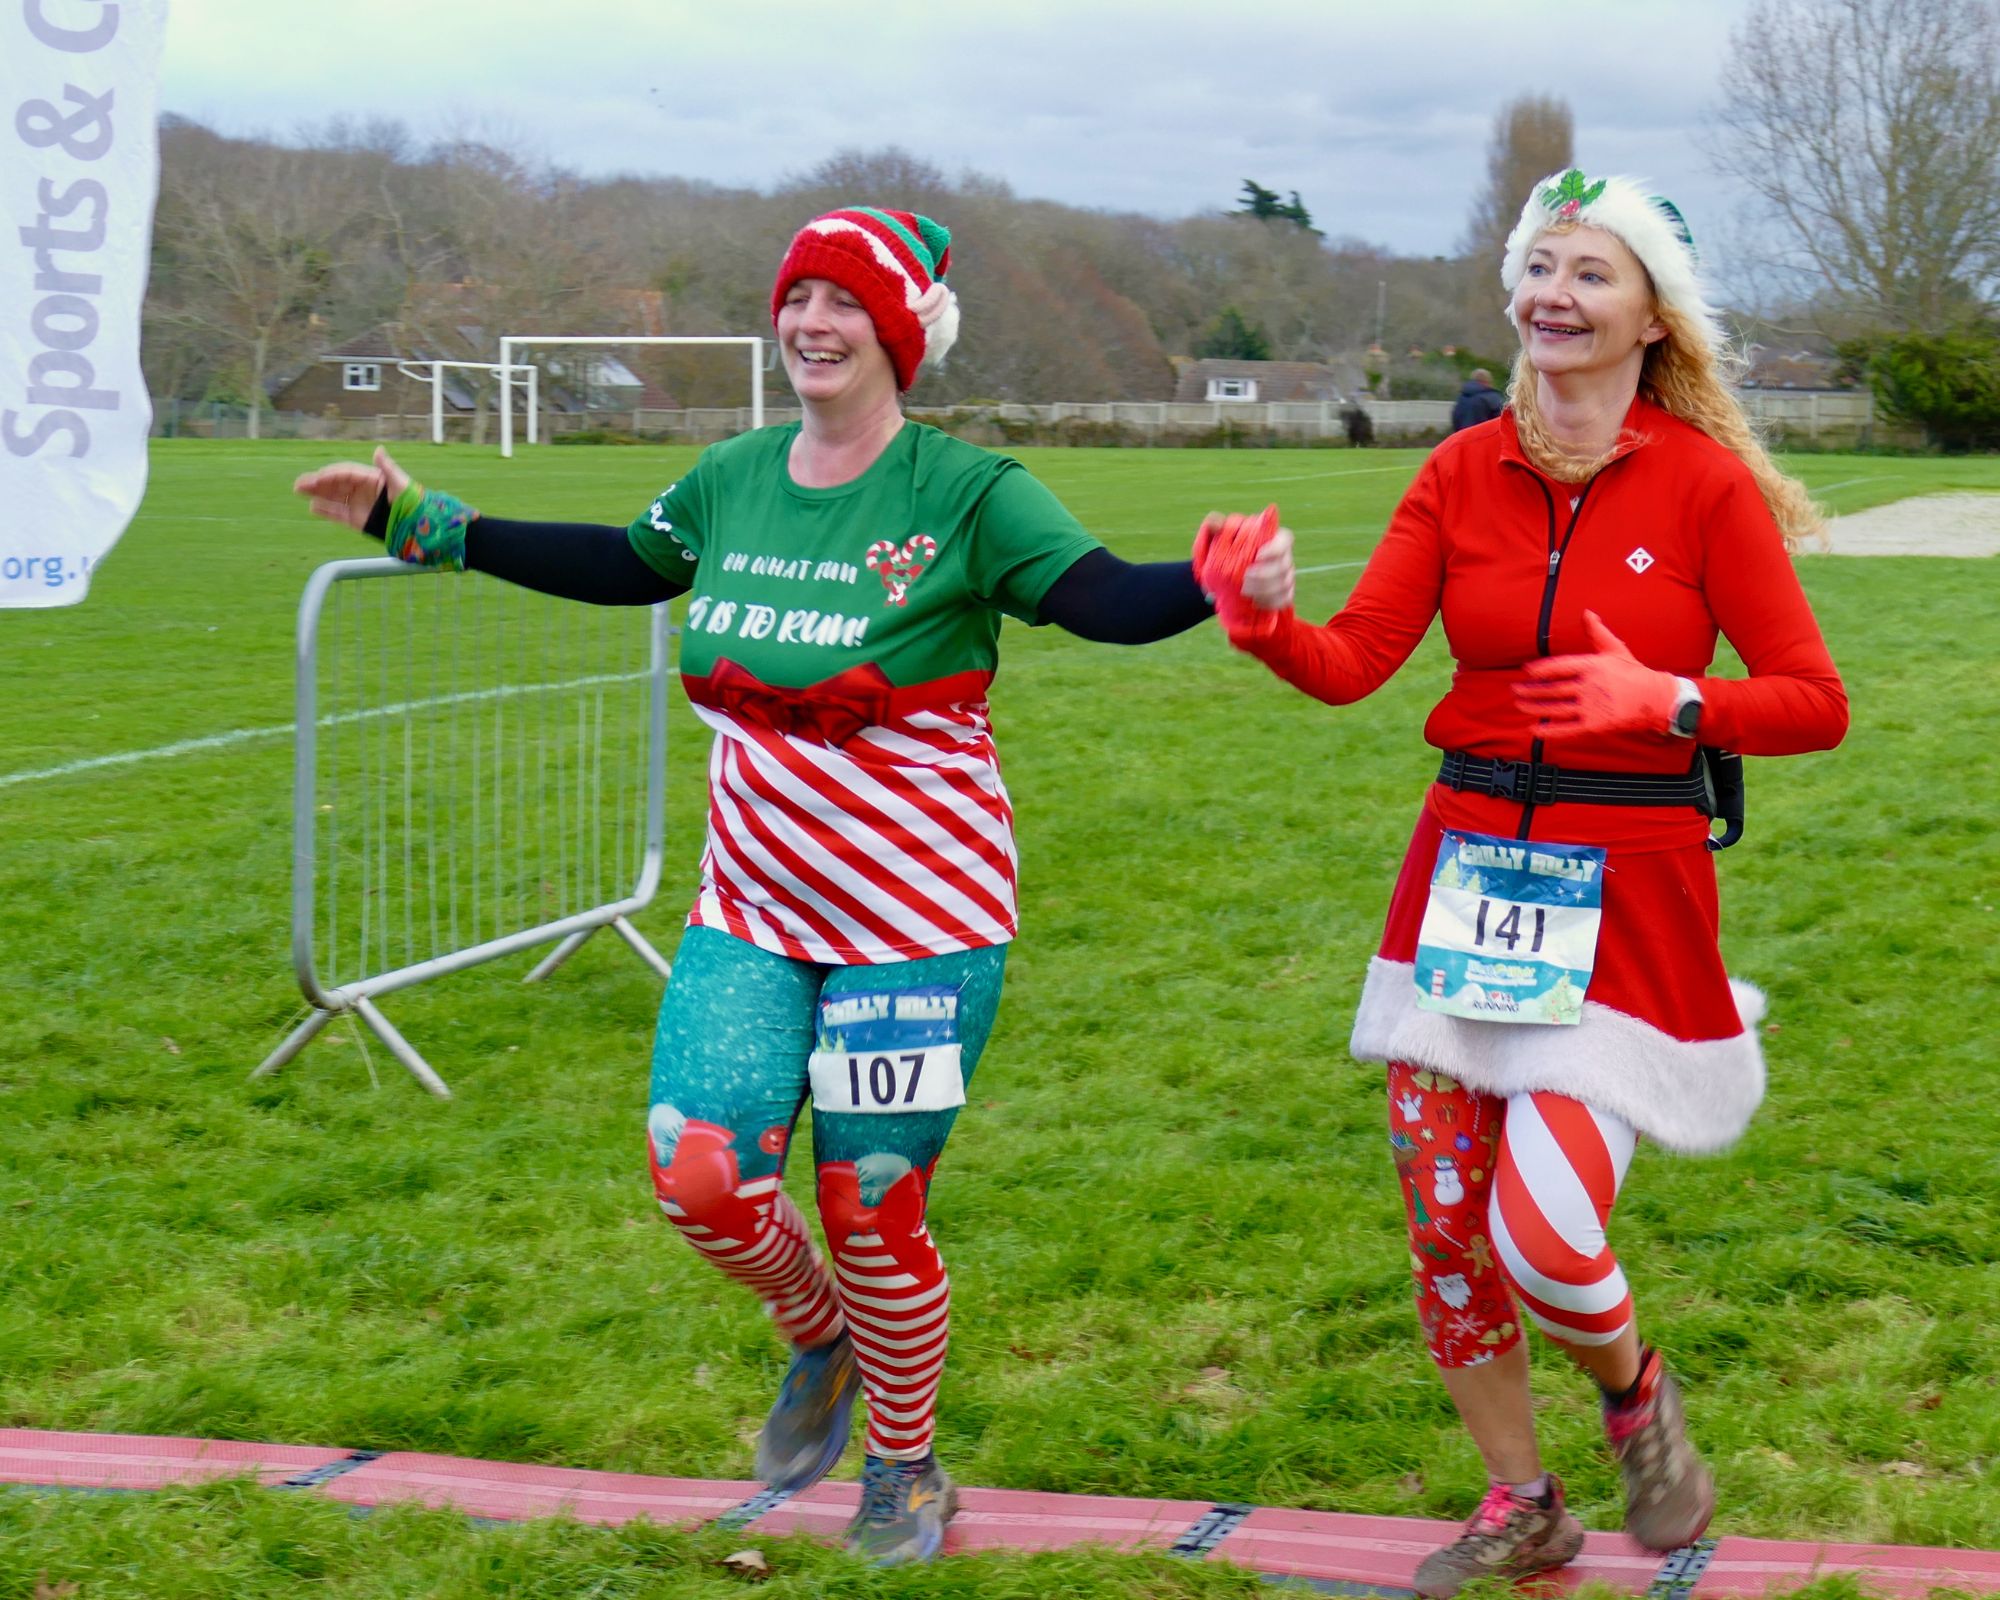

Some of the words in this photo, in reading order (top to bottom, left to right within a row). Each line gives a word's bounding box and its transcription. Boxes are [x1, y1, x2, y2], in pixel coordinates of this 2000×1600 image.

[23, 0, 120, 53] C
[15, 83, 115, 161] &
[2, 176, 120, 458] Sports
[751, 556, 812, 581] WHAT
[814, 560, 858, 585] FUN
[706, 600, 738, 635] IS
[738, 603, 776, 640] TO
[1474, 899, 1545, 952] 141
[848, 1053, 925, 1106] 107
